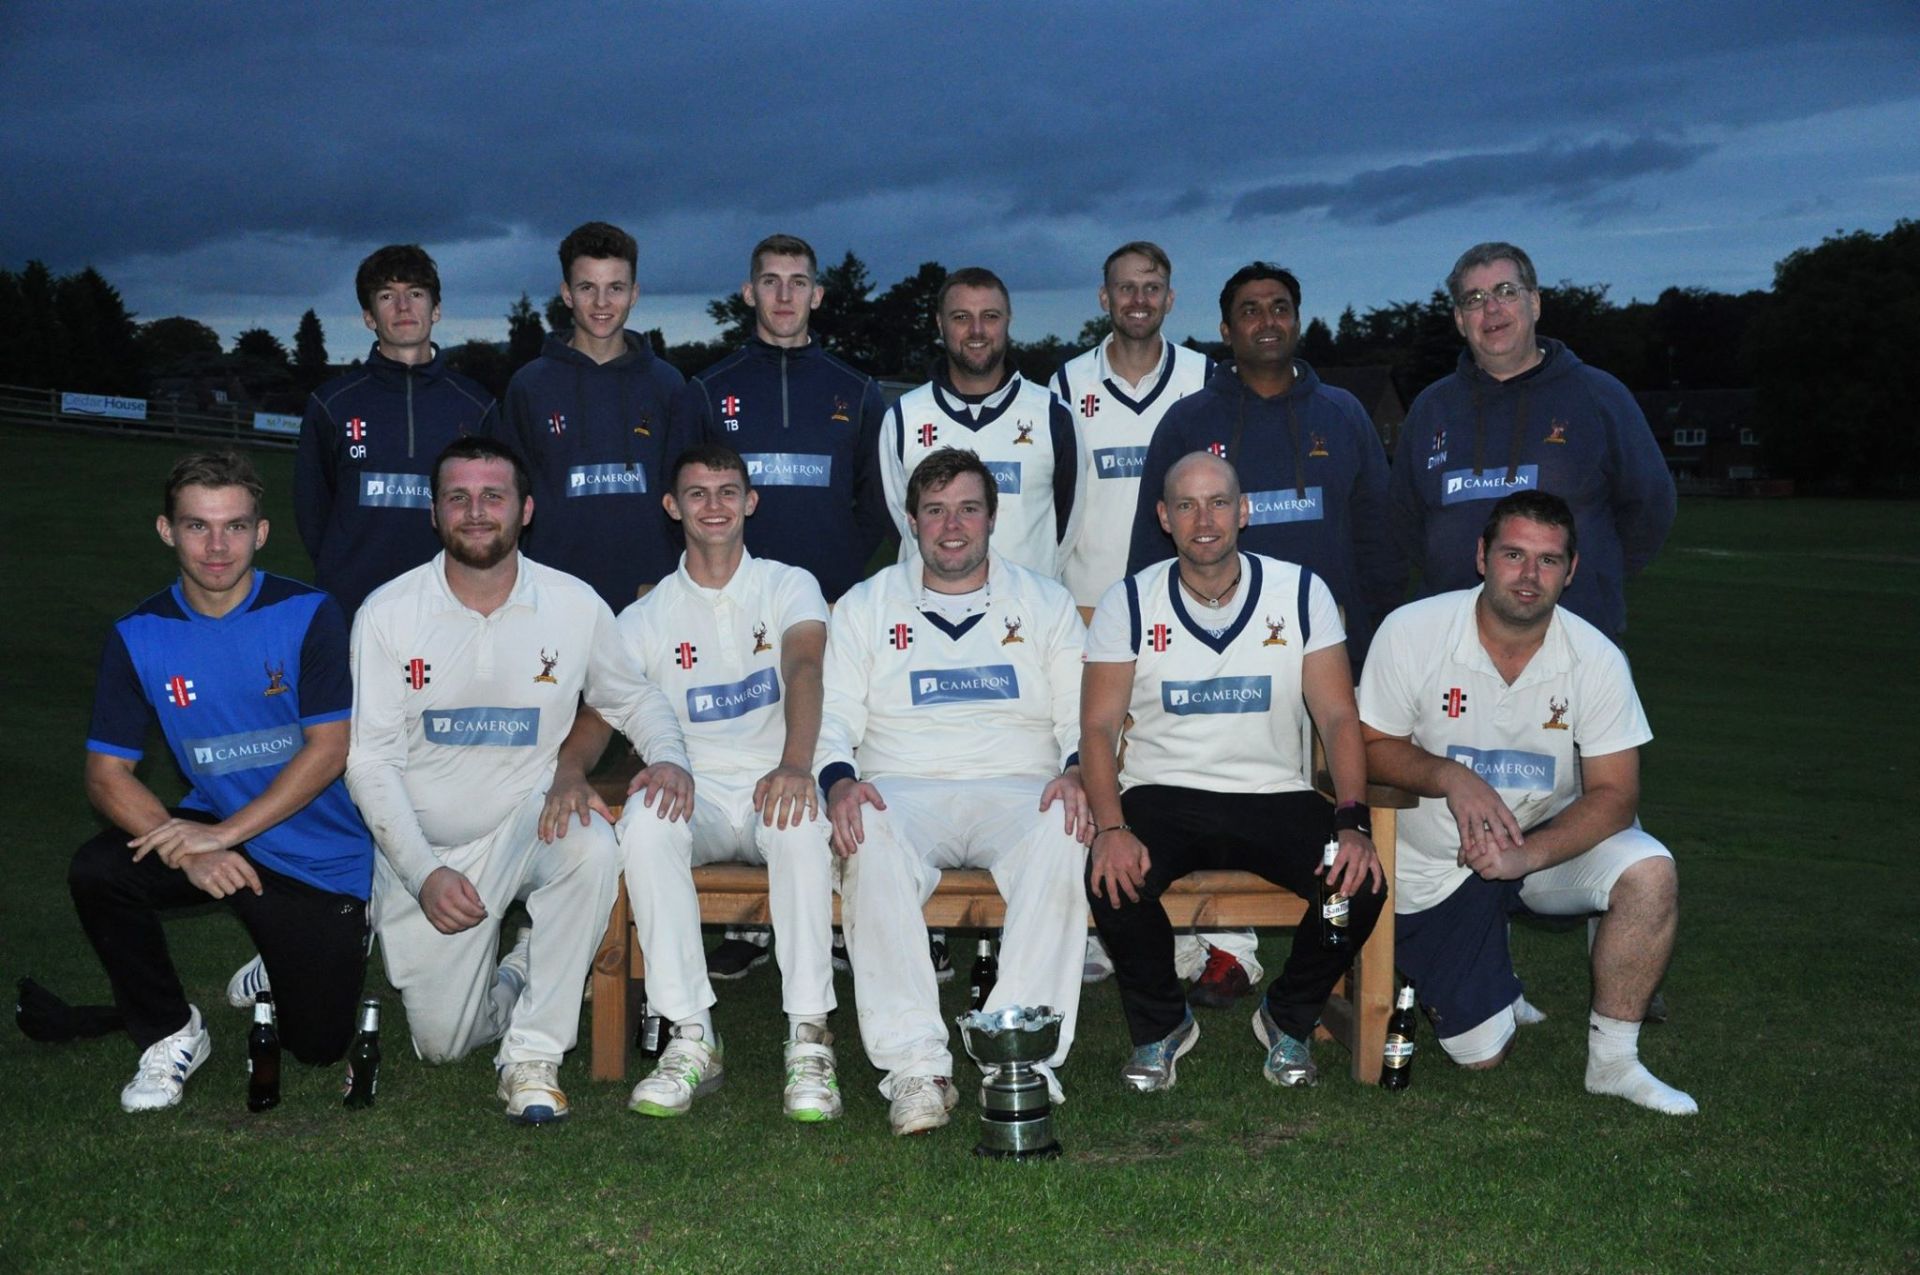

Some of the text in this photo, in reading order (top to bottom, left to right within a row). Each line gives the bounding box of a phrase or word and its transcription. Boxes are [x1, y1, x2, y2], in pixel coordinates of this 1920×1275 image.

[104, 398, 145, 411] House
[724, 419, 740, 431] TB
[349, 445, 367, 458] OR
[764, 463, 824, 477] CAMERON
[586, 471, 640, 486] CAMERON
[386, 484, 432, 499] CAMER
[1255, 498, 1316, 512] CAMERON
[940, 676, 1010, 691] CAMERON
[715, 681, 772, 707] CAMERON
[1191, 688, 1263, 703] CAMERON
[454, 719, 530, 735] CAMERON
[215, 736, 293, 761] CAMERON
[1474, 762, 1546, 778] CAMERON
